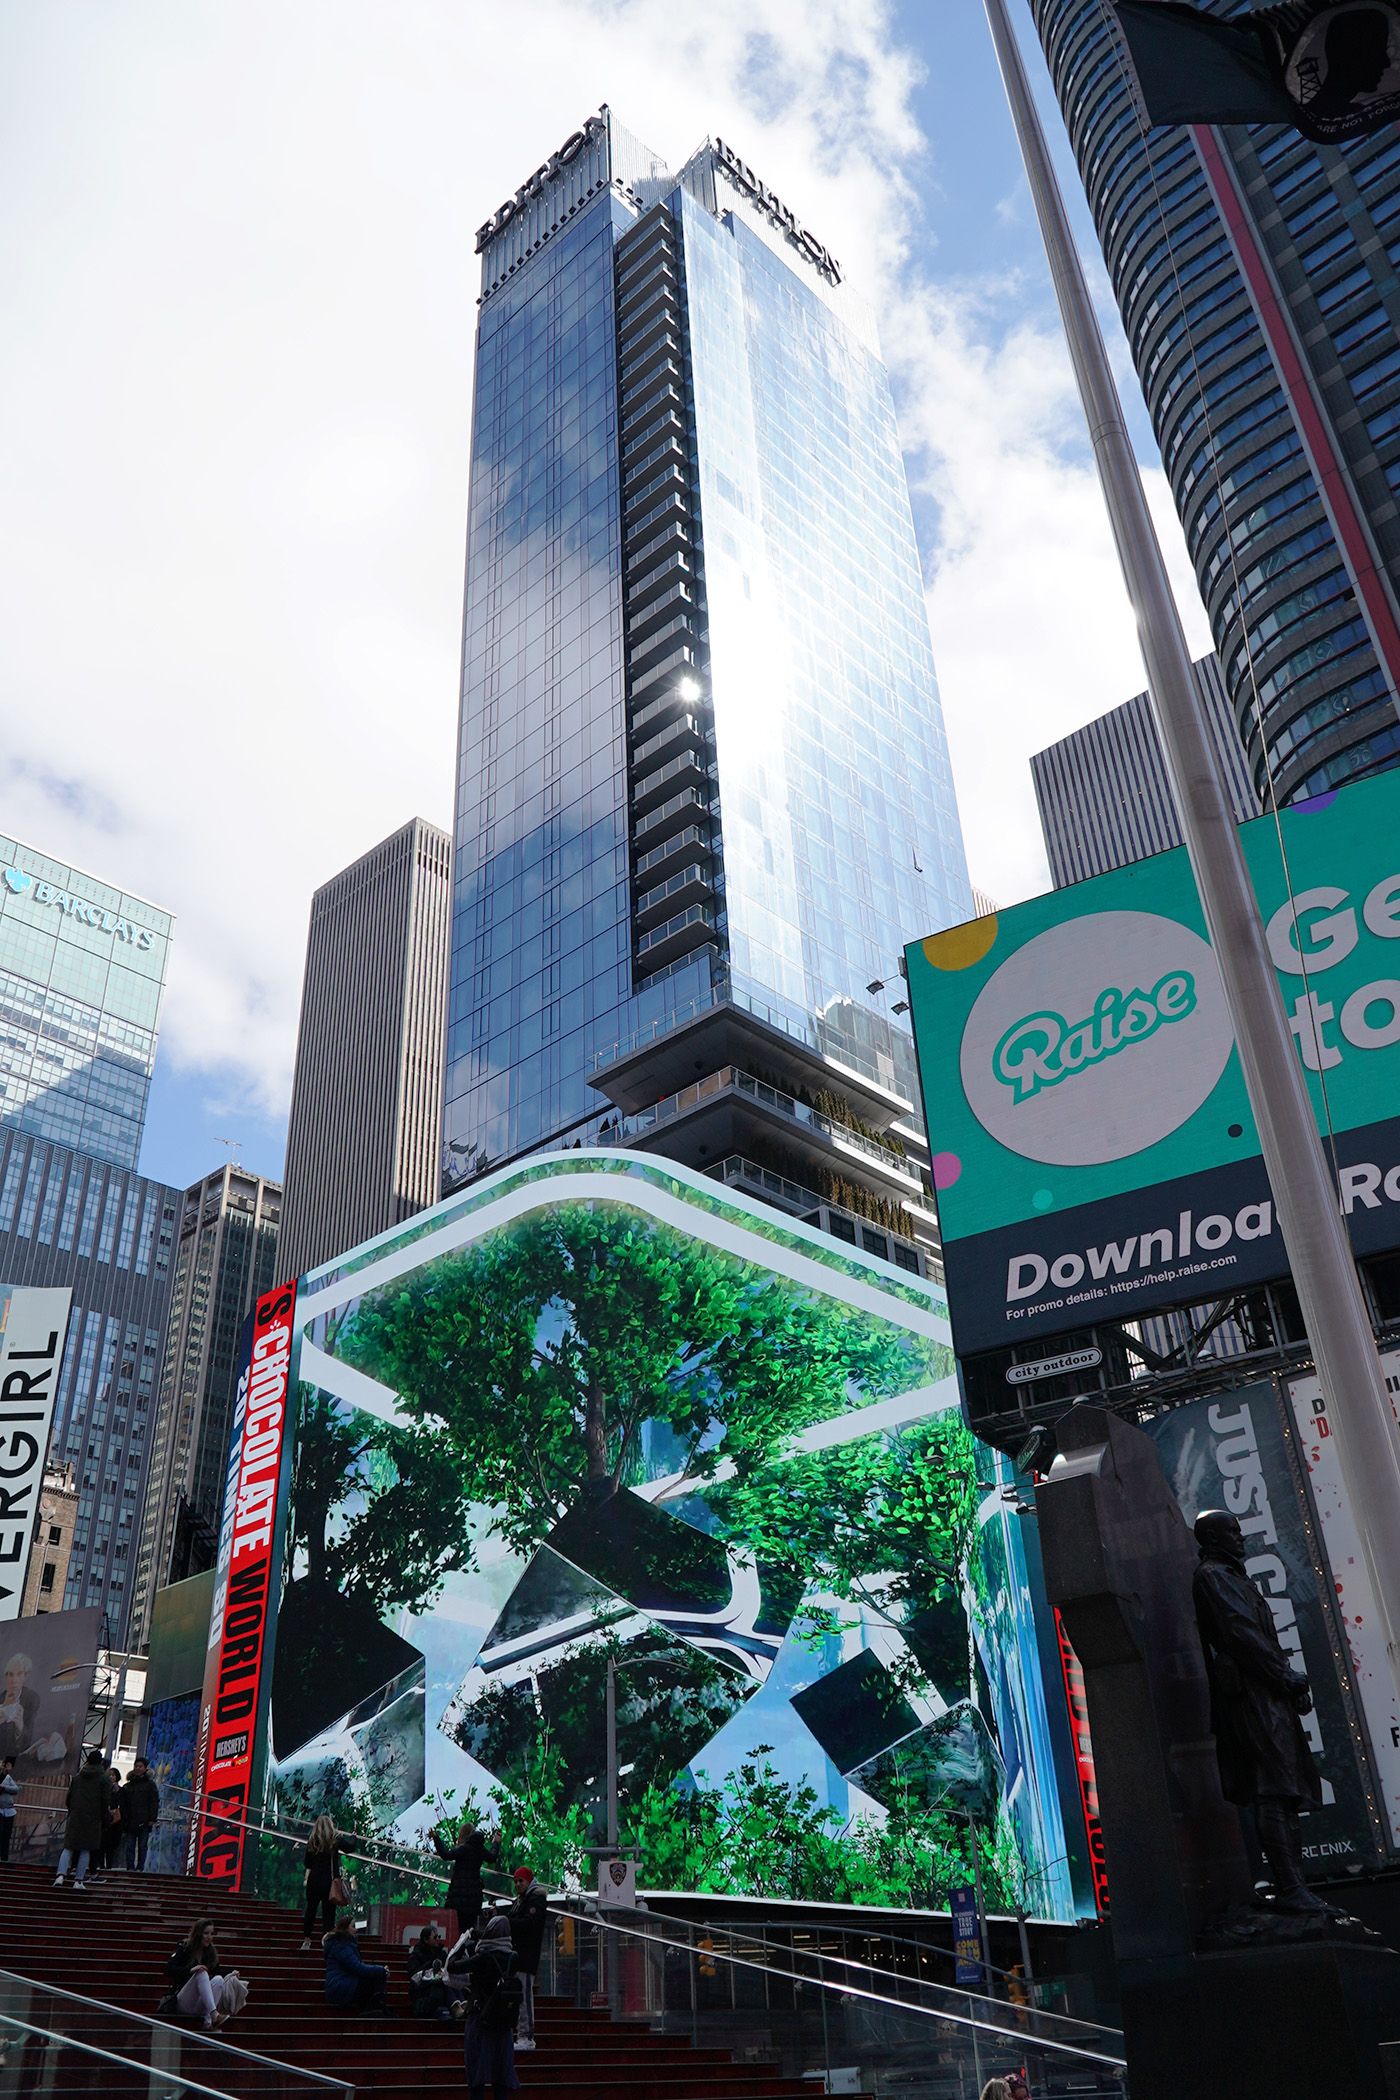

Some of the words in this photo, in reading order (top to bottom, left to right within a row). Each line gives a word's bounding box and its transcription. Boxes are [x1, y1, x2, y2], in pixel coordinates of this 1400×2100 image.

[1342, 117, 1363, 129] NOT
[475, 103, 609, 255] EDITION
[714, 137, 846, 289] EDITION
[35, 882, 155, 950] BARCLAYS
[993, 970, 1197, 1105] Raise
[1288, 979, 1400, 1072] to
[1006, 1201, 1283, 1303] Downloa
[1006, 1308, 1025, 1321] For
[1028, 1299, 1064, 1317] promo
[1066, 1288, 1108, 1306] details:
[1110, 1254, 1238, 1295] https://help.raise.com
[1015, 1364, 1040, 1379] city
[1043, 1351, 1095, 1372] outdoor
[232, 1324, 290, 1558] CHOCOLATE
[1207, 1401, 1279, 1547] JUST
[218, 1430, 244, 1574] TIMES
[217, 1558, 267, 1724] WORLD
[216, 1735, 247, 1759] HERSHEY'S
[1320, 1840, 1355, 1857] ENIX
